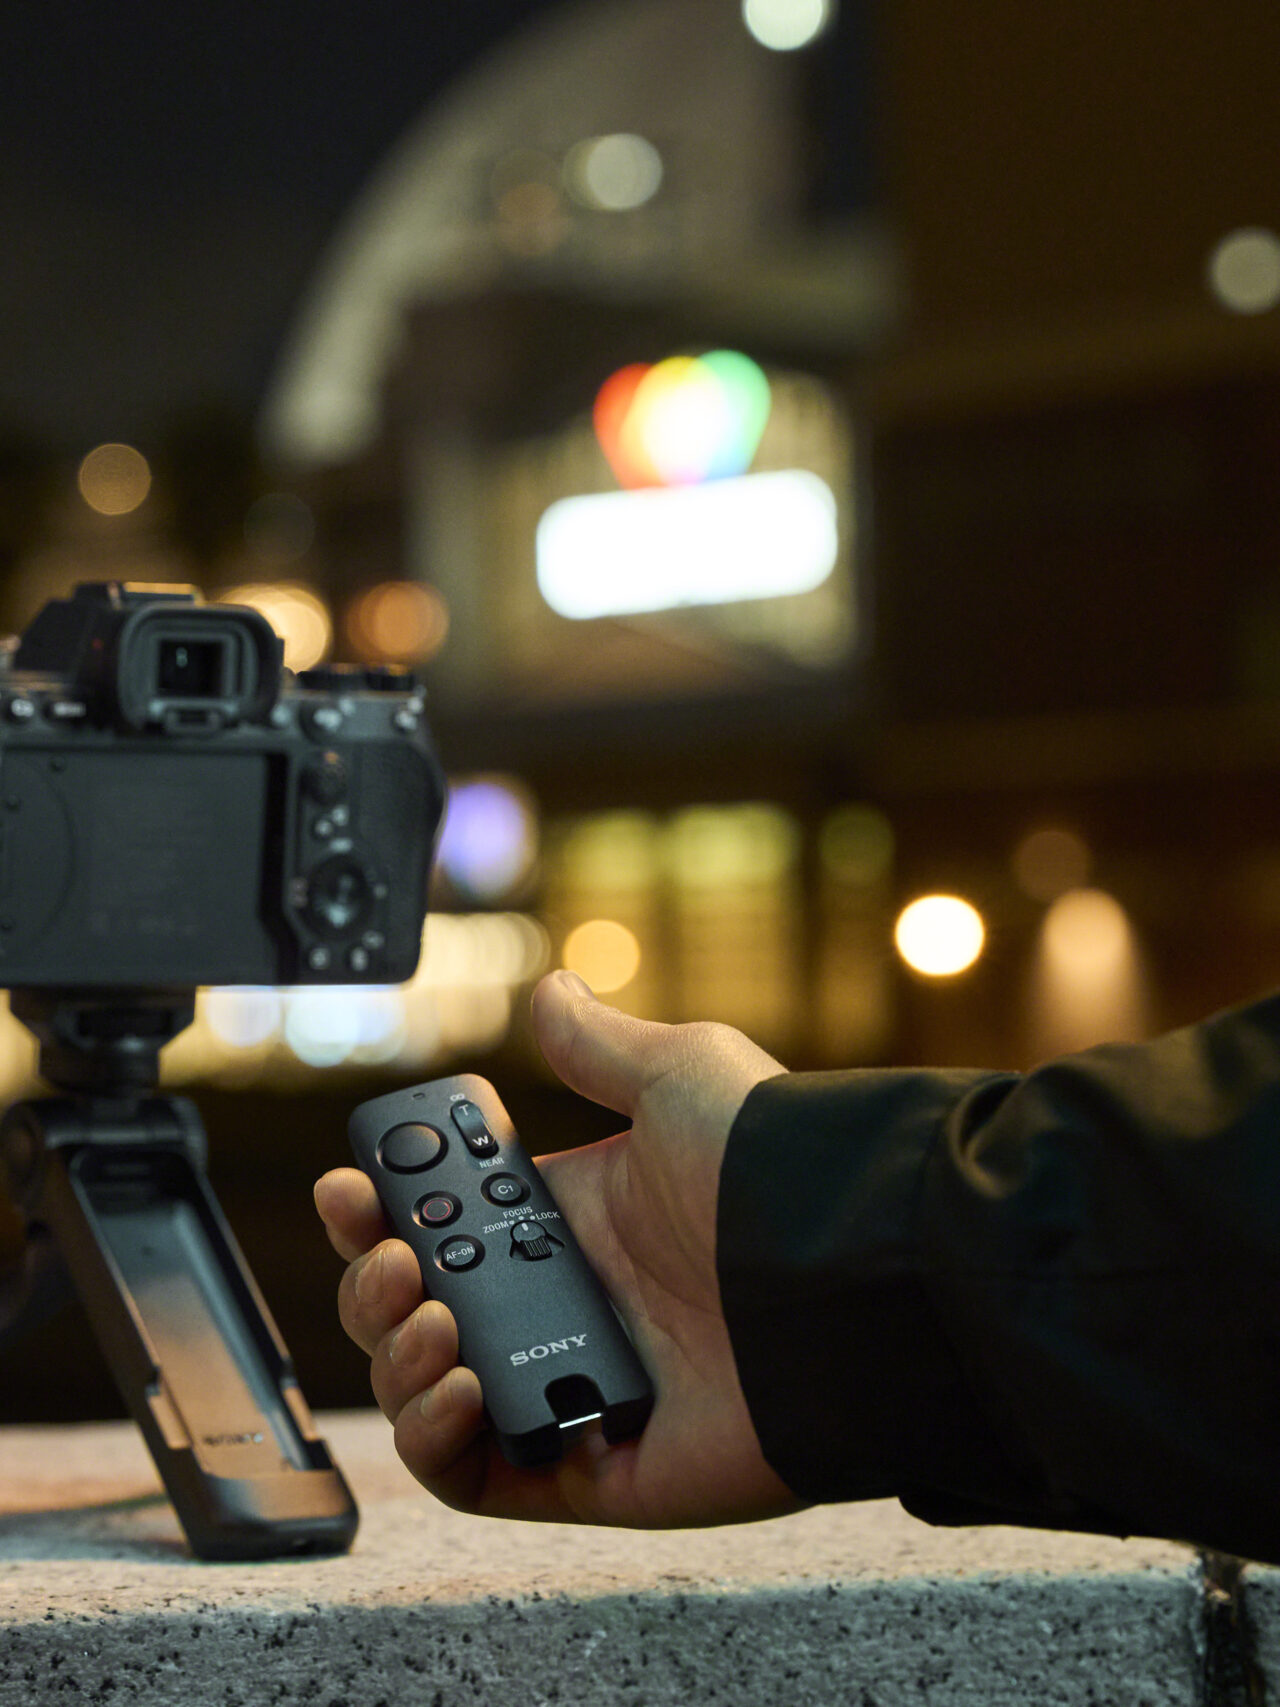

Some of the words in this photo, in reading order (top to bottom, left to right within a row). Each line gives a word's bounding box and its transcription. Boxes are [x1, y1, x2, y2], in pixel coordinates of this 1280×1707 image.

[458, 1104, 469, 1116] T
[472, 1135, 489, 1146] W
[479, 1157, 505, 1168] NEAR
[497, 1184, 514, 1194] C1
[502, 1206, 533, 1219] FOCUS
[535, 1211, 560, 1220] LOCK
[482, 1220, 509, 1234] ZOOM
[446, 1246, 475, 1262] AF-ON
[510, 1333, 588, 1366] SONY
